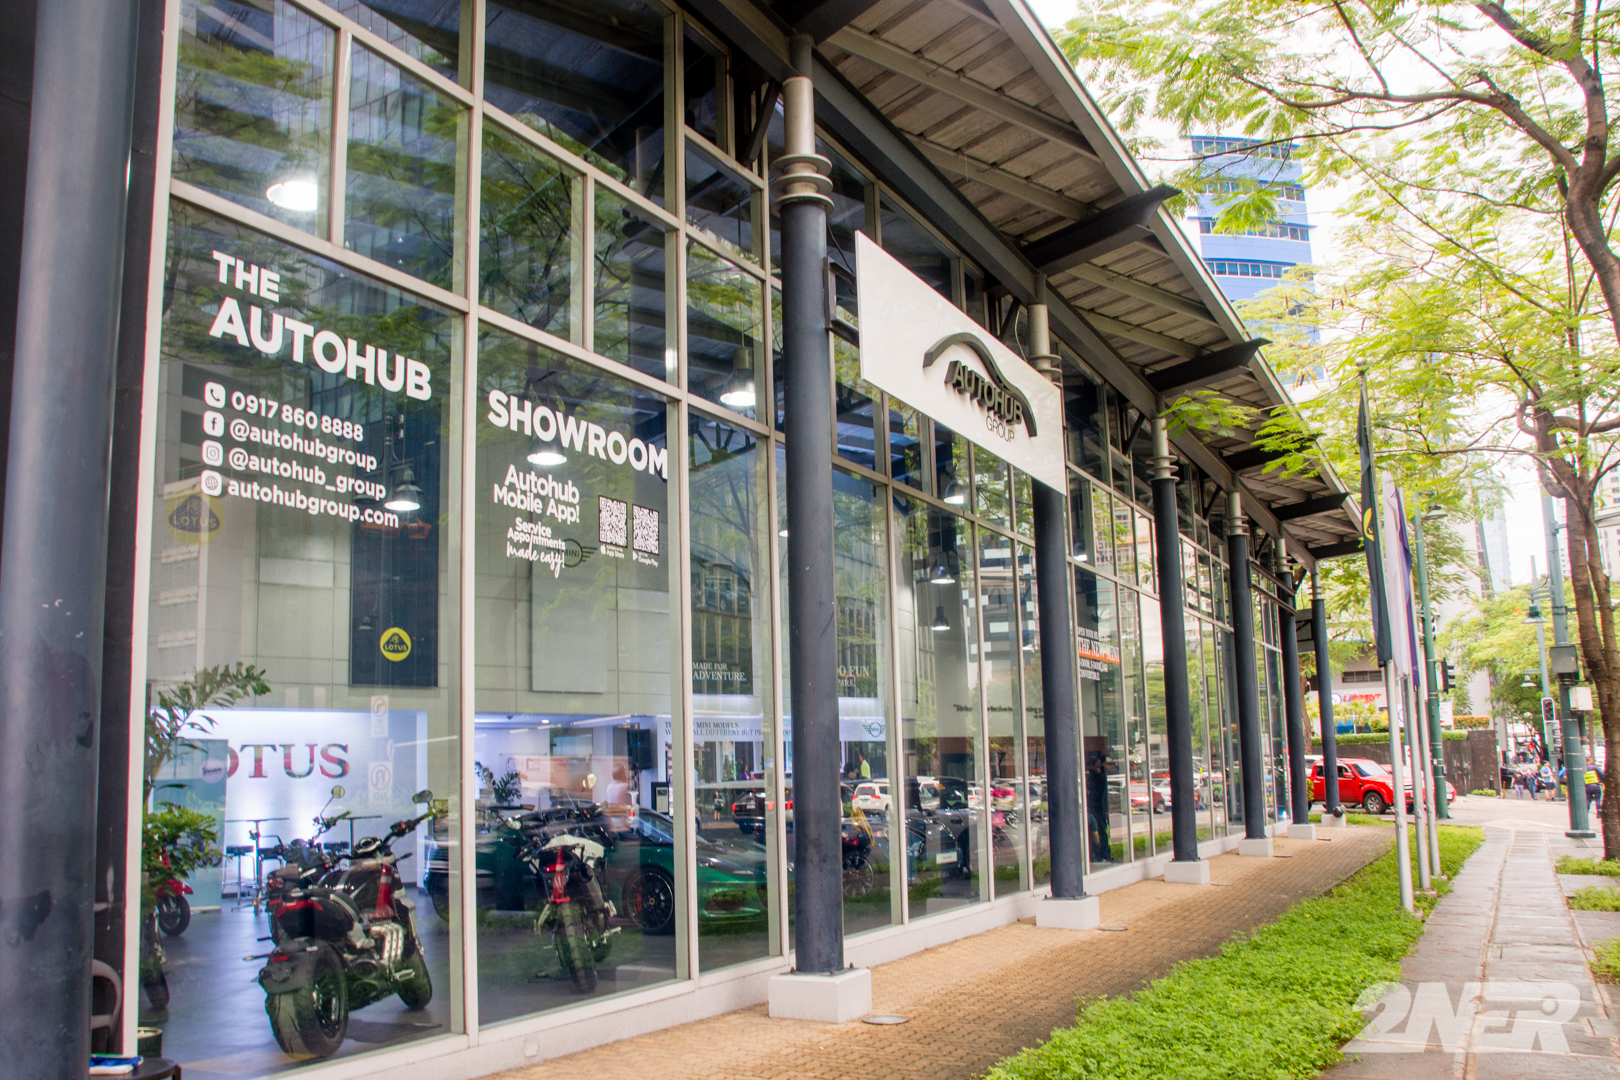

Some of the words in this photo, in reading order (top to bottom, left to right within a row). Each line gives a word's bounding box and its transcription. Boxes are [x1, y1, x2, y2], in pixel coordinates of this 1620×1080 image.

[212, 250, 280, 303] THE
[209, 296, 432, 401] AUTOHUB
[947, 360, 1023, 425] AUTOHUB
[231, 390, 279, 419] 0917
[281, 404, 319, 430] 860
[321, 415, 364, 442] 8888
[985, 415, 1015, 443] GROUP
[229, 418, 378, 473] @autohubgroup
[487, 389, 668, 480] SHOWROOM
[228, 447, 387, 501] @autohub_group
[504, 464, 580, 504] Autohub
[227, 479, 400, 529] autohubgroup.com
[493, 483, 543, 515] Mobile
[546, 498, 580, 525] App!
[173, 515, 217, 528] LOTUS
[507, 527, 566, 550] Appointments
[515, 516, 552, 538] Service
[506, 538, 539, 562] made
[384, 643, 408, 652] LOTUS
[1078, 637, 1091, 656] THE
[1091, 640, 1105, 659] NEW
[1106, 643, 1120, 663] MINI
[692, 662, 713, 671] MADE
[714, 663, 728, 671] FOR
[693, 670, 747, 681] ADVENTURE.
[850, 665, 869, 677] FUN
